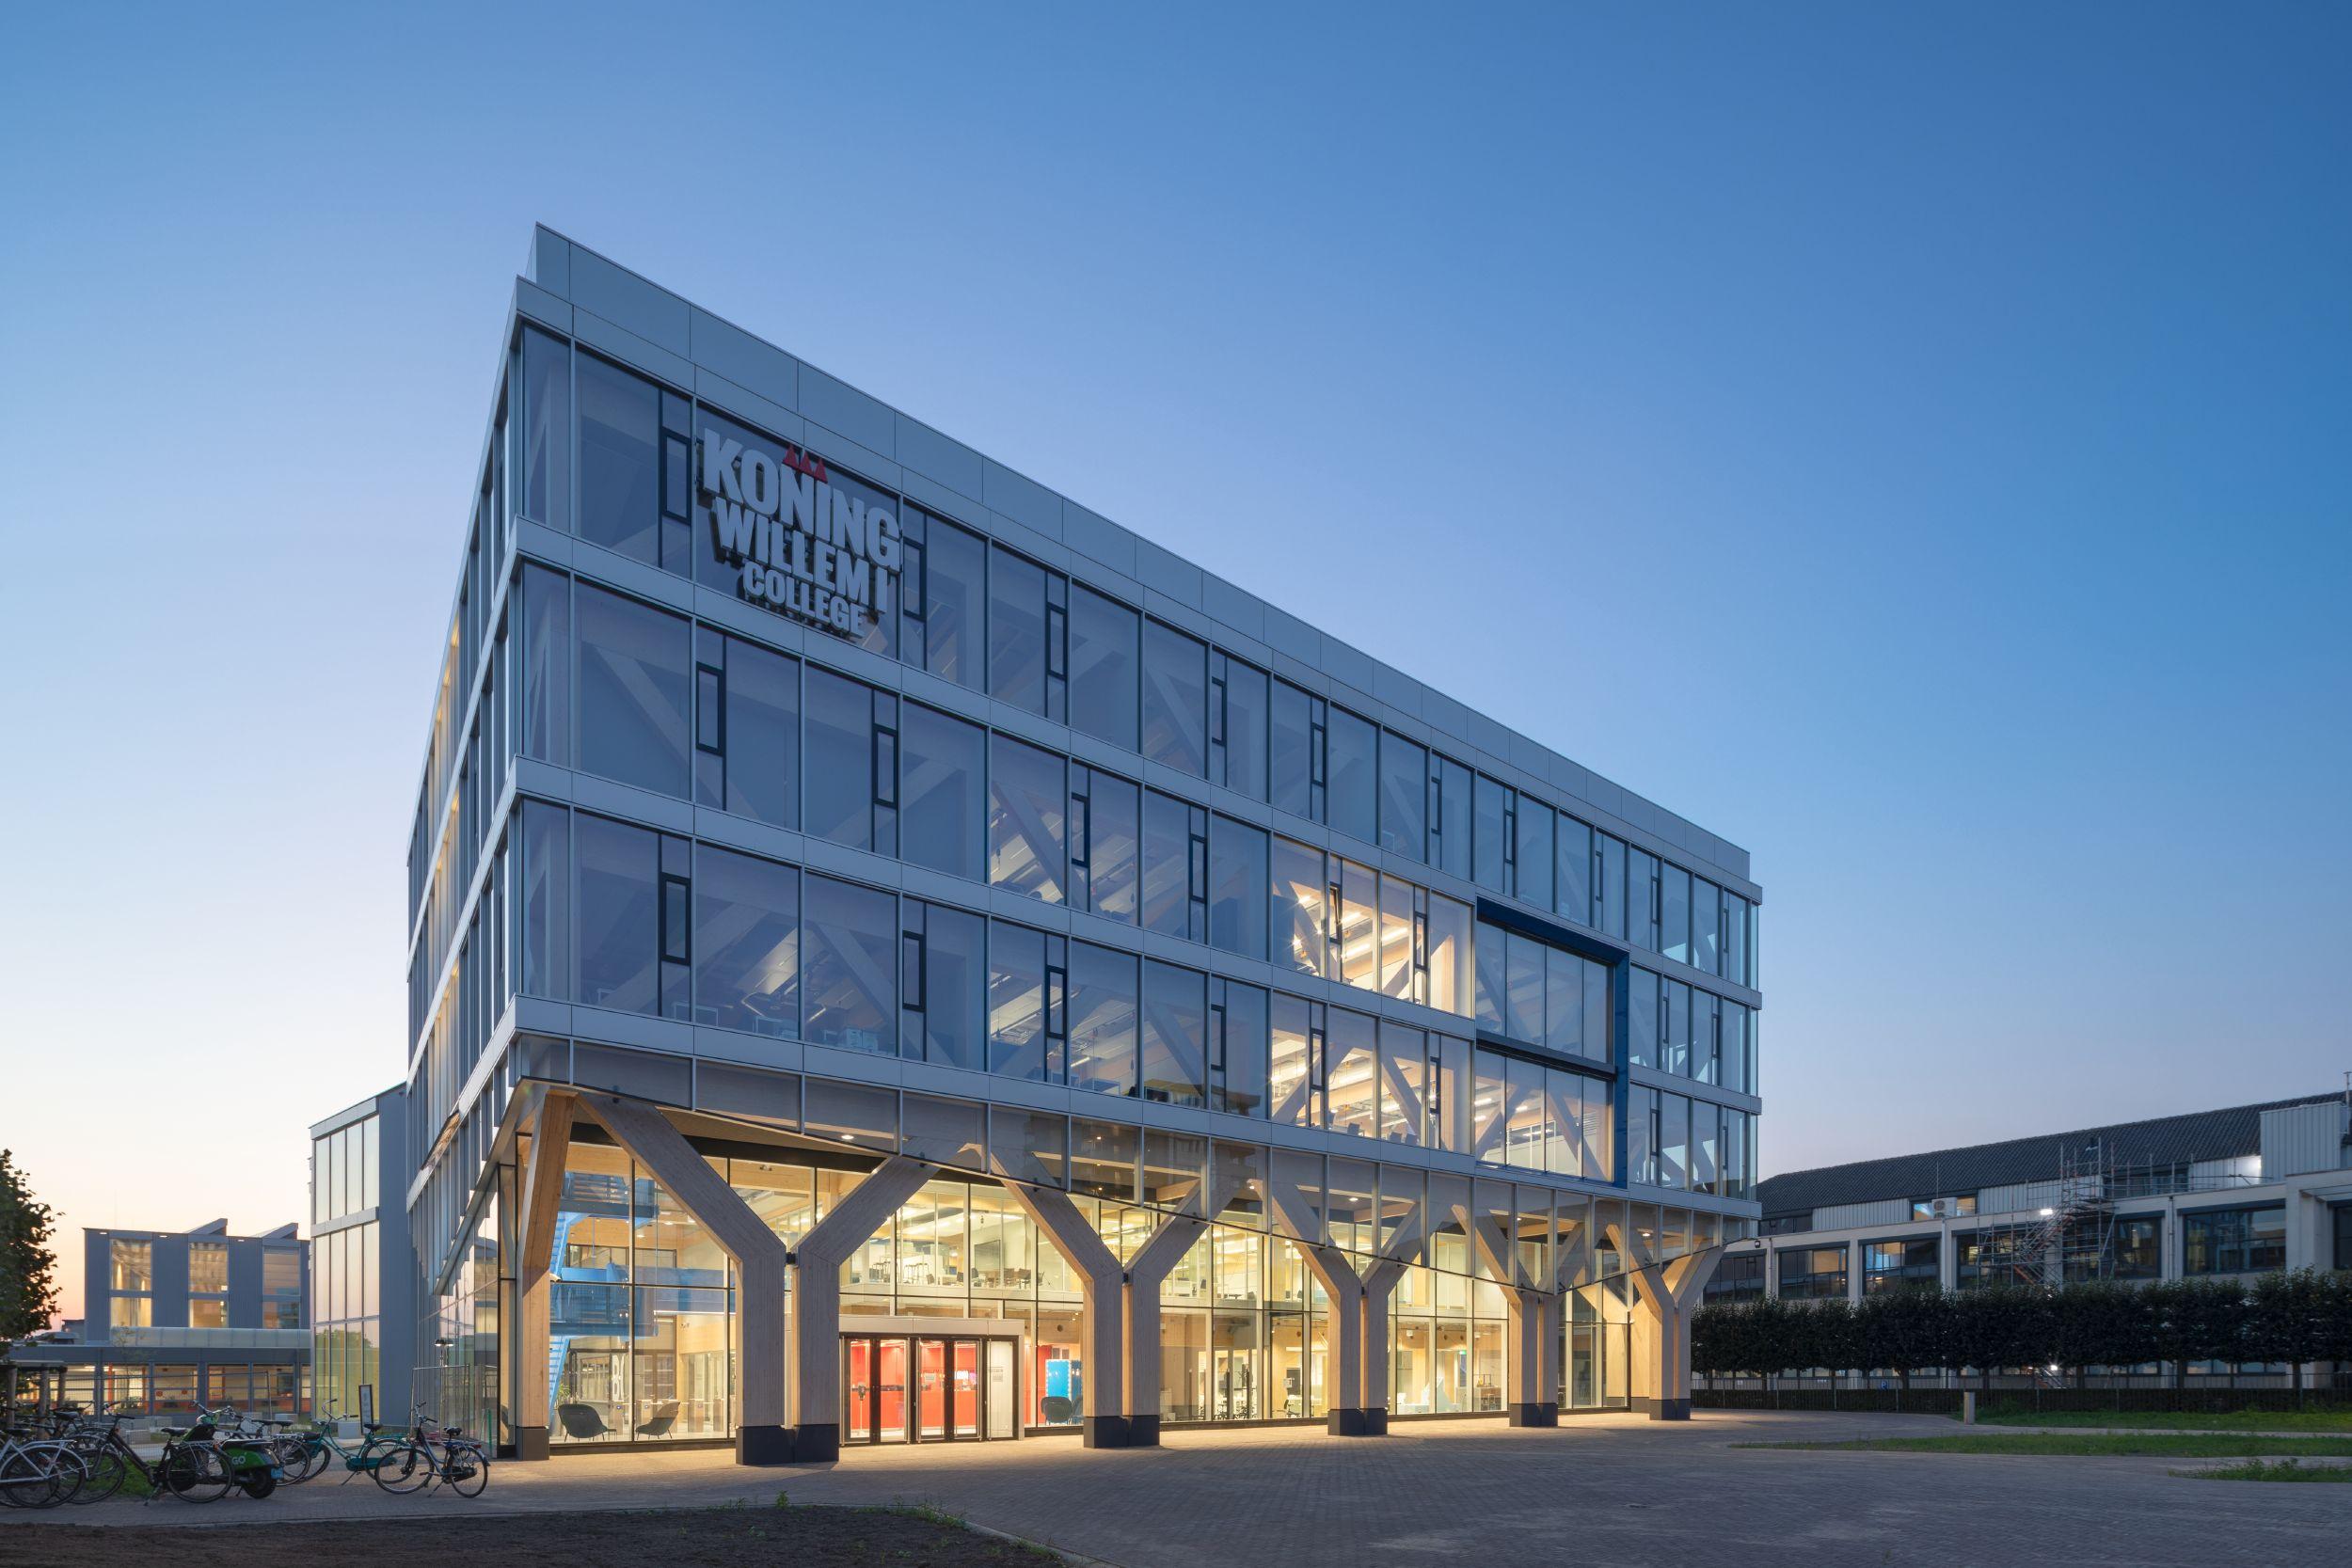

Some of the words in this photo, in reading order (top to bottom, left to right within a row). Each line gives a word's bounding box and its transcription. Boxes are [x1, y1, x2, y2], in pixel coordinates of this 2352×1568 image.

[704, 428, 900, 572] KONING
[715, 497, 869, 607] WILLEM
[742, 562, 866, 639] COLLEGE
[231, 1456, 246, 1465] GO
